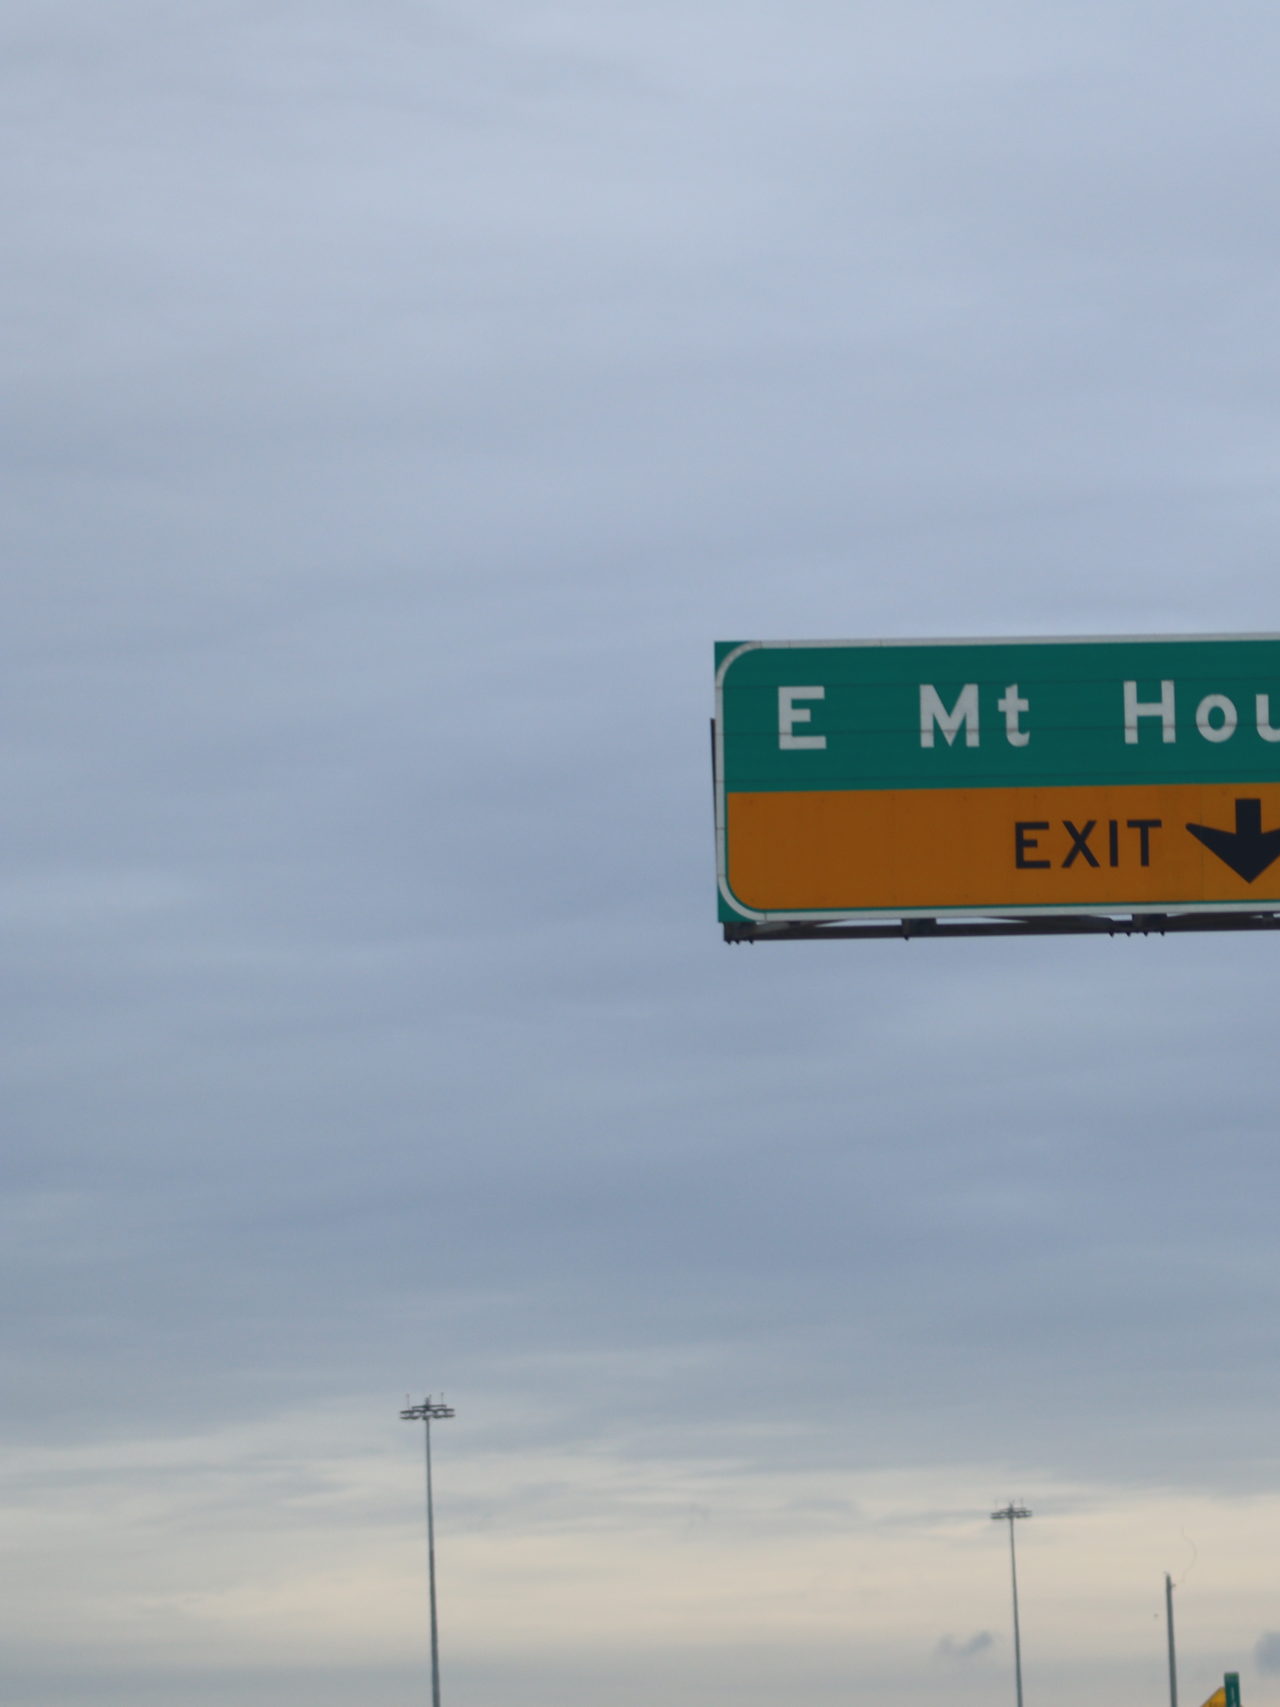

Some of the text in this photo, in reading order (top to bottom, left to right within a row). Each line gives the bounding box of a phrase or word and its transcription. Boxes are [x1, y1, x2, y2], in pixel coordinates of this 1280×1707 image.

[778, 686, 826, 750] E
[918, 682, 1032, 749] Mt
[1014, 818, 1163, 871] EXIT
